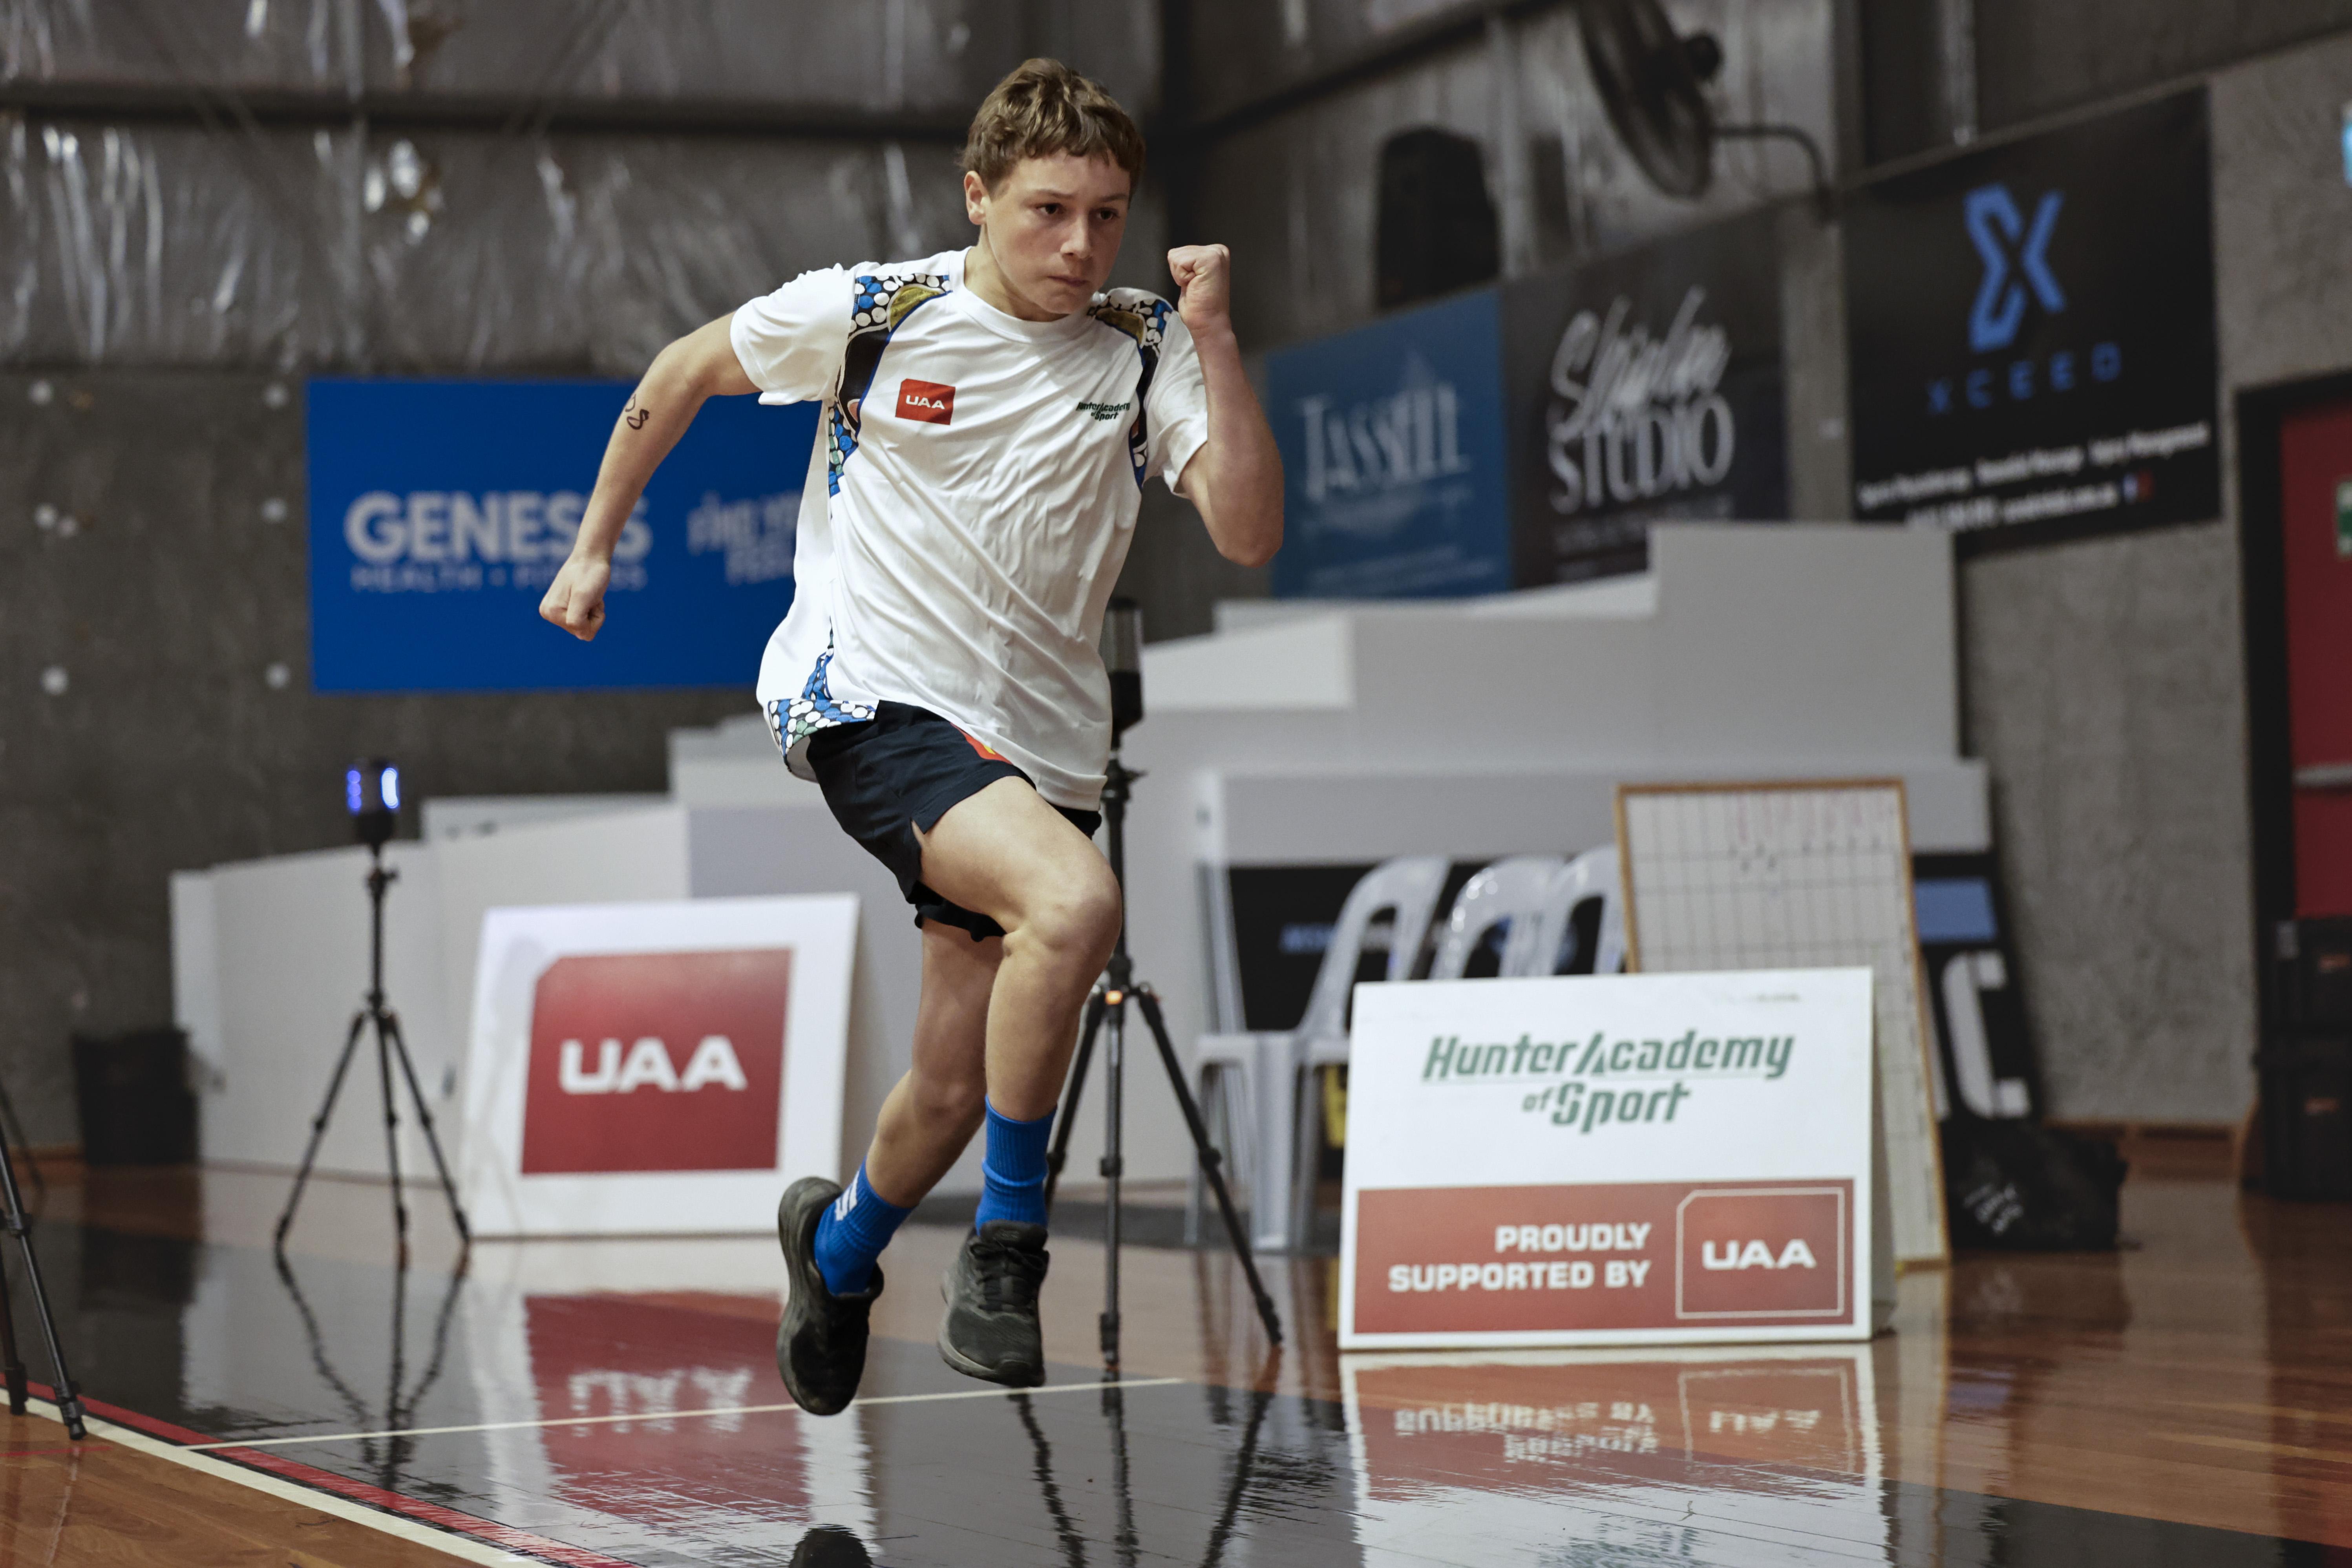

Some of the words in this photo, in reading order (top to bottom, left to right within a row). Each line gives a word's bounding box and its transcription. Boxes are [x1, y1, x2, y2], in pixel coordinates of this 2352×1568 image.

[906, 395, 945, 409] UAA
[1095, 411, 1118, 421] Sport
[345, 491, 653, 563] GENESS
[558, 1035, 748, 1095] UAA
[1552, 1082, 1690, 1133] Sport
[1495, 1222, 1651, 1253] PROUDLY
[1702, 1239, 1817, 1270] UAA
[1388, 1261, 1595, 1292] SUPPORTED
[1605, 1259, 1651, 1288] BY
